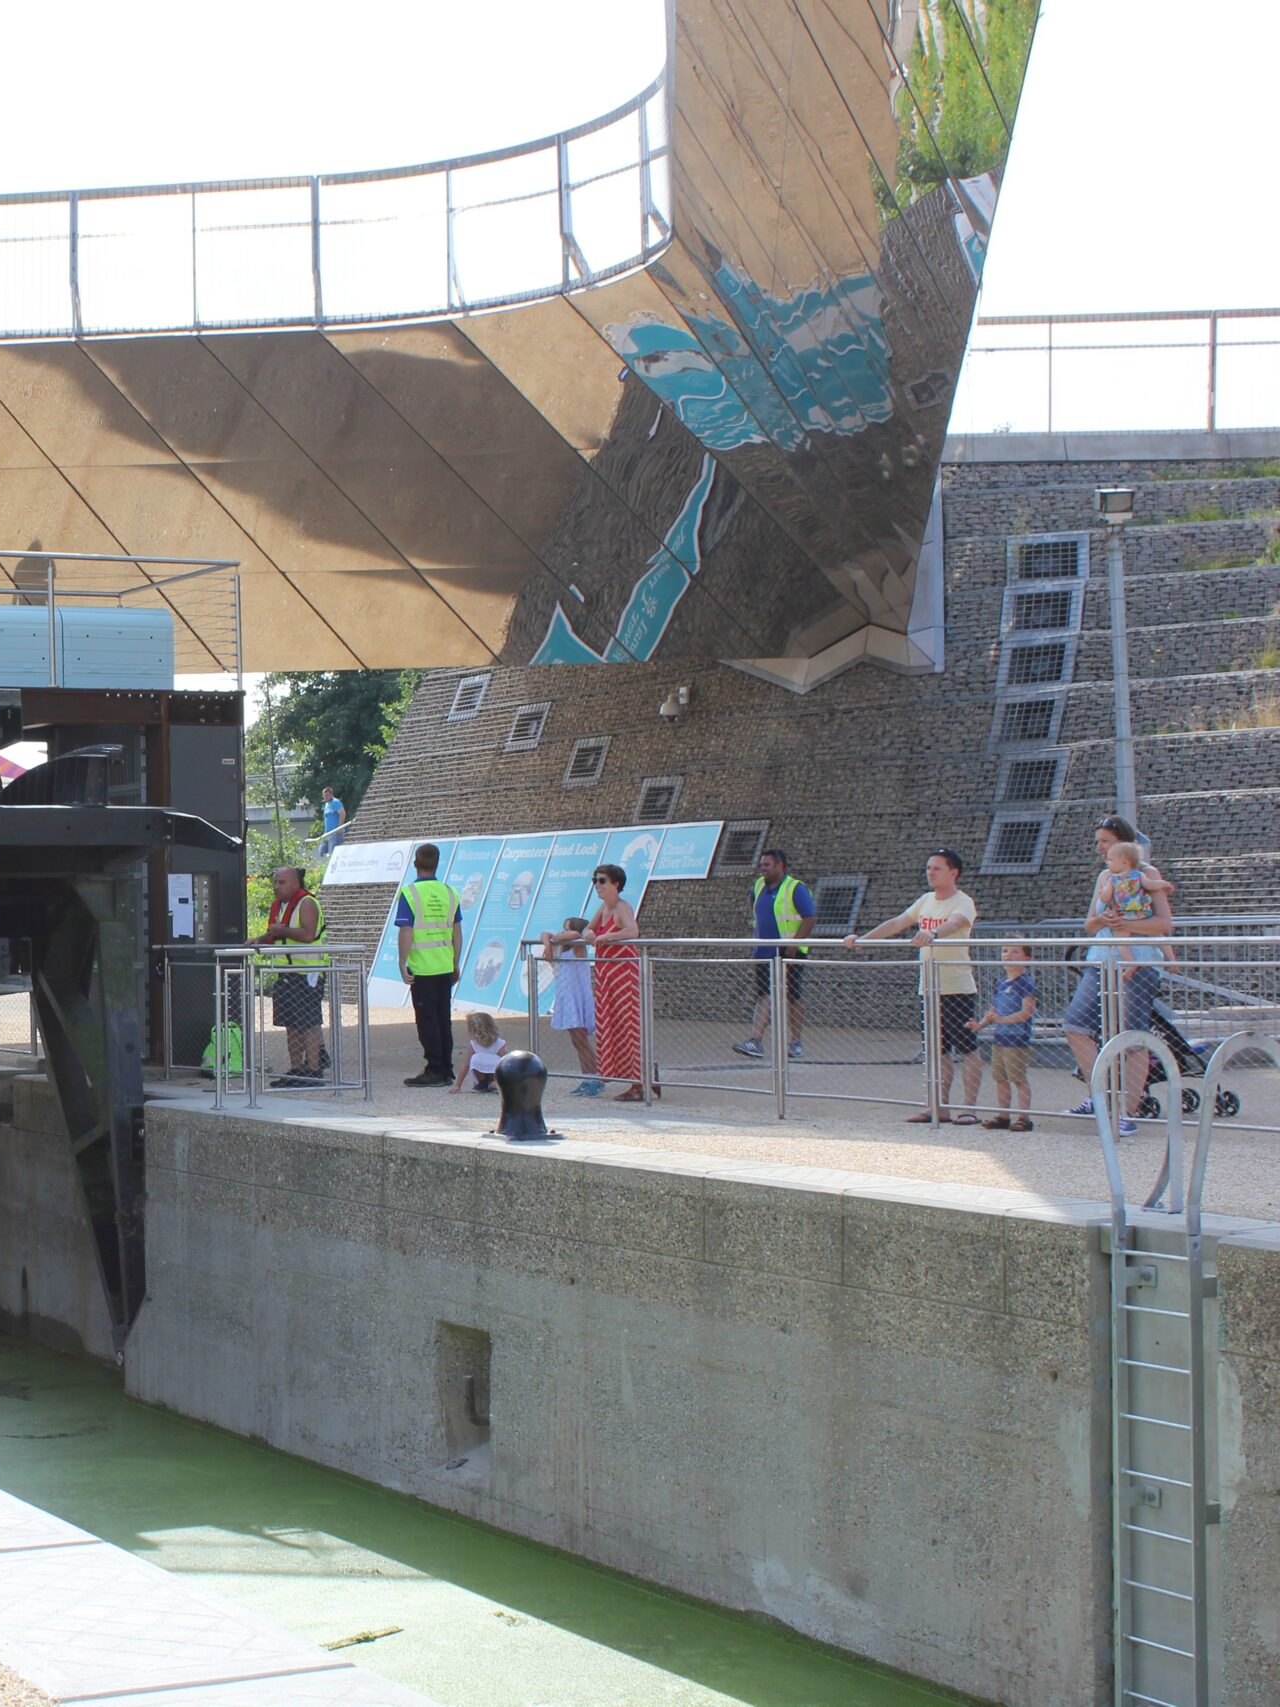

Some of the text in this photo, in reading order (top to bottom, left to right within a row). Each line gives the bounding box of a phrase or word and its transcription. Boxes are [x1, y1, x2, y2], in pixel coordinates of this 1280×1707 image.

[502, 847, 549, 862] Carpenters
[552, 844, 573, 856] Road
[576, 843, 598, 855] Lock
[682, 856, 705, 868] Trust
